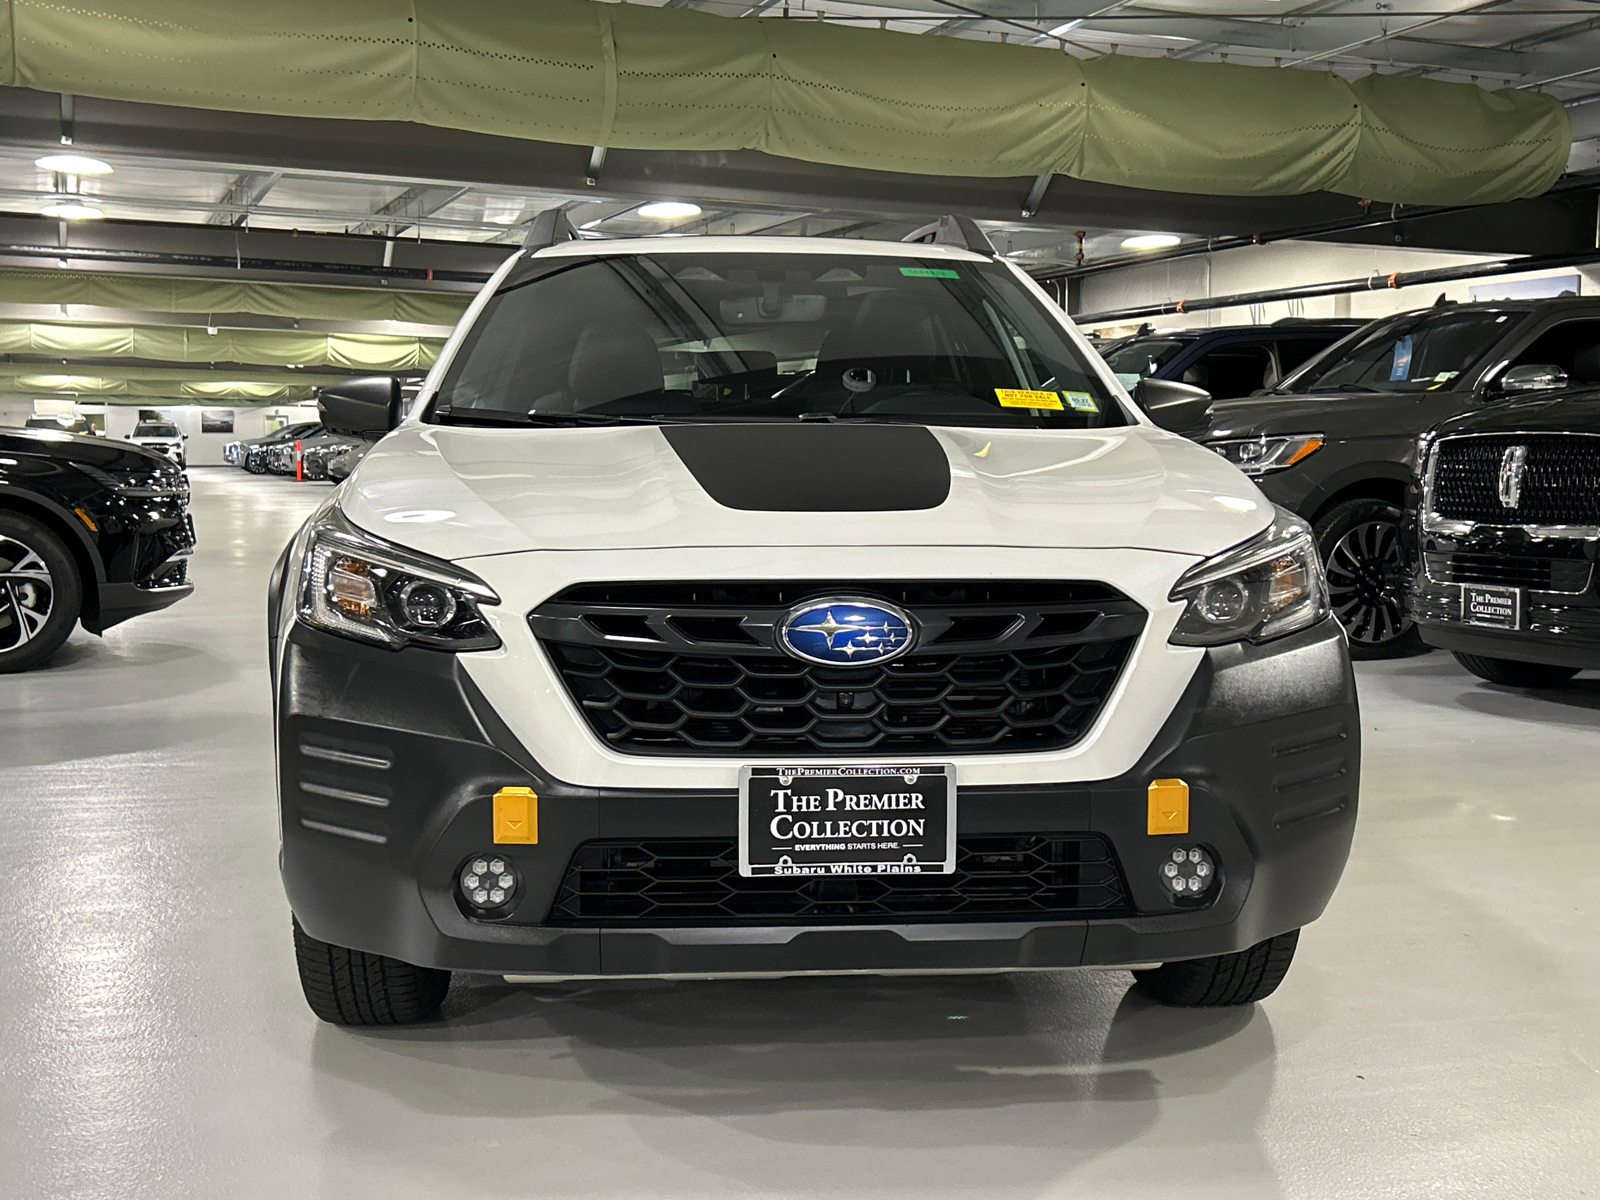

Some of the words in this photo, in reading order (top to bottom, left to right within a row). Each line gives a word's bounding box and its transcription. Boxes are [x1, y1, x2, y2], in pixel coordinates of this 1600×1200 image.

[1470, 592, 1484, 602] THE
[1485, 593, 1512, 605] PREMIER
[1470, 602, 1512, 616] COLLECTION
[770, 789, 821, 813] THE
[825, 788, 925, 811] PREMIER
[769, 814, 926, 840] COLLECTION
[794, 843, 846, 851] EVERYTHING
[847, 842, 876, 850] STARTS
[877, 842, 900, 850] HERE.
[773, 865, 826, 875] Subaru
[830, 865, 872, 874] White
[877, 864, 921, 873] Plains
